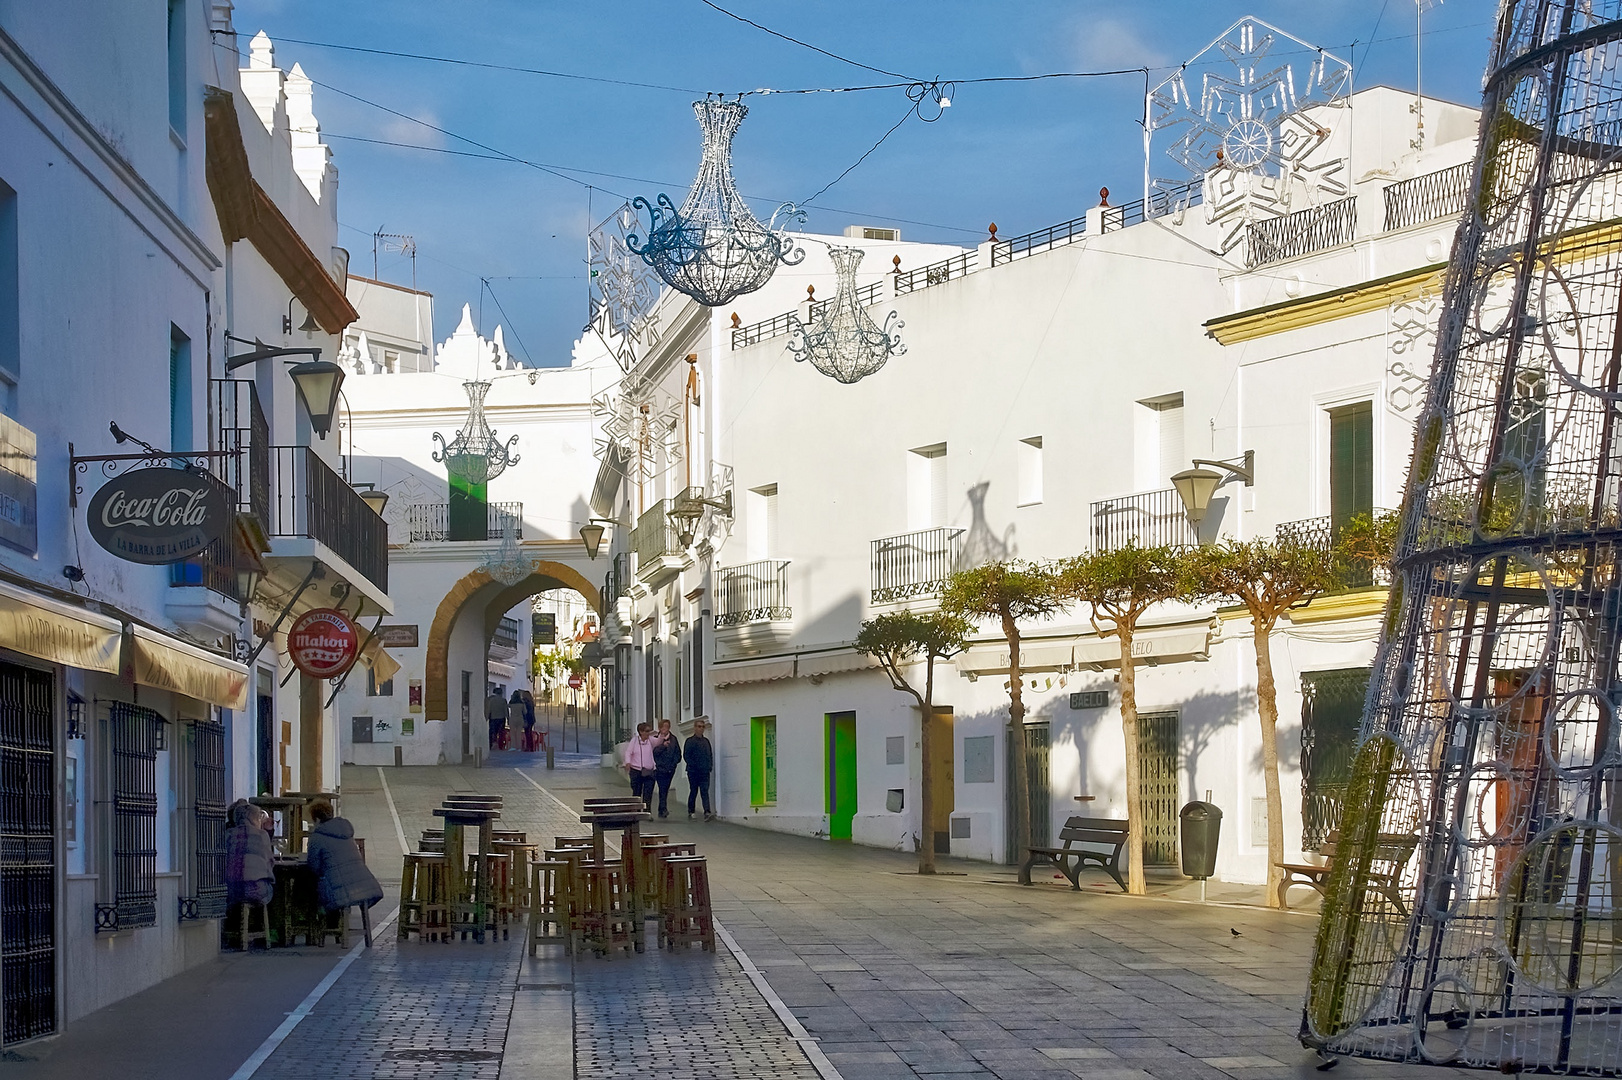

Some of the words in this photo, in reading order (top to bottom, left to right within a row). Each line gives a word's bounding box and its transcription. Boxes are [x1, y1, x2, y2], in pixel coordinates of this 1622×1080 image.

[101, 488, 210, 528] Coca-Cola
[117, 537, 127, 551] LA
[128, 542, 154, 556] BARRA
[156, 545, 166, 556] DE
[167, 543, 177, 555] LA
[178, 535, 200, 551] VILLA
[301, 619, 311, 628] LA
[311, 613, 346, 631] TABERNITA
[296, 634, 348, 648] Mahou
[1000, 652, 1026, 667] BAO
[1071, 692, 1103, 708] BAELO
